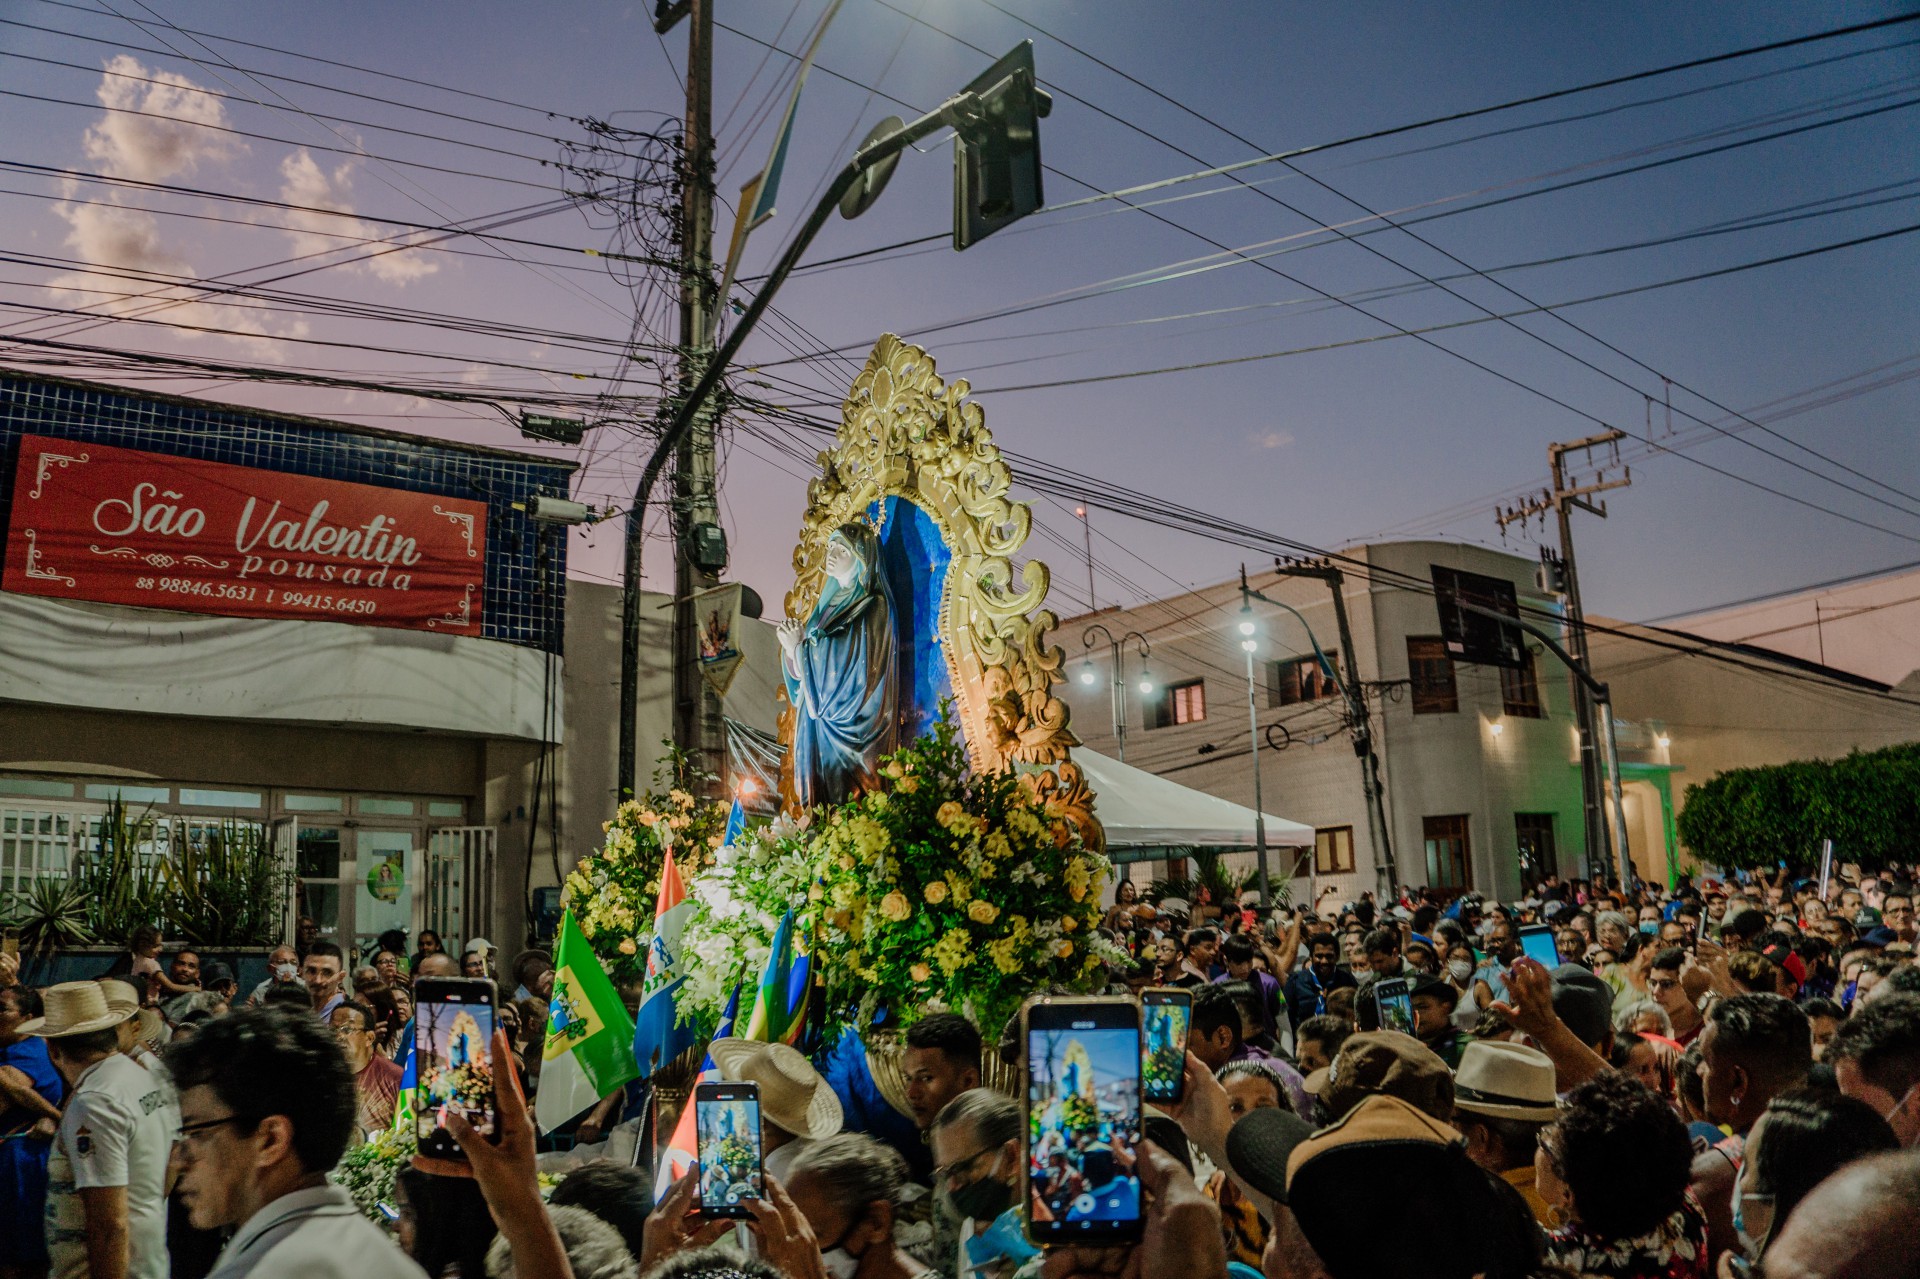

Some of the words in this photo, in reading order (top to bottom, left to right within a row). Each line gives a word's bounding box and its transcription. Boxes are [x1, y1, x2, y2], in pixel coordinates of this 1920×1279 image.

[93, 482, 206, 537] São
[235, 496, 422, 566] Valentin
[237, 554, 413, 590] pousada
[136, 577, 155, 590] 88
[158, 577, 255, 601] 98846.5631
[282, 591, 377, 614] 99415.6450
